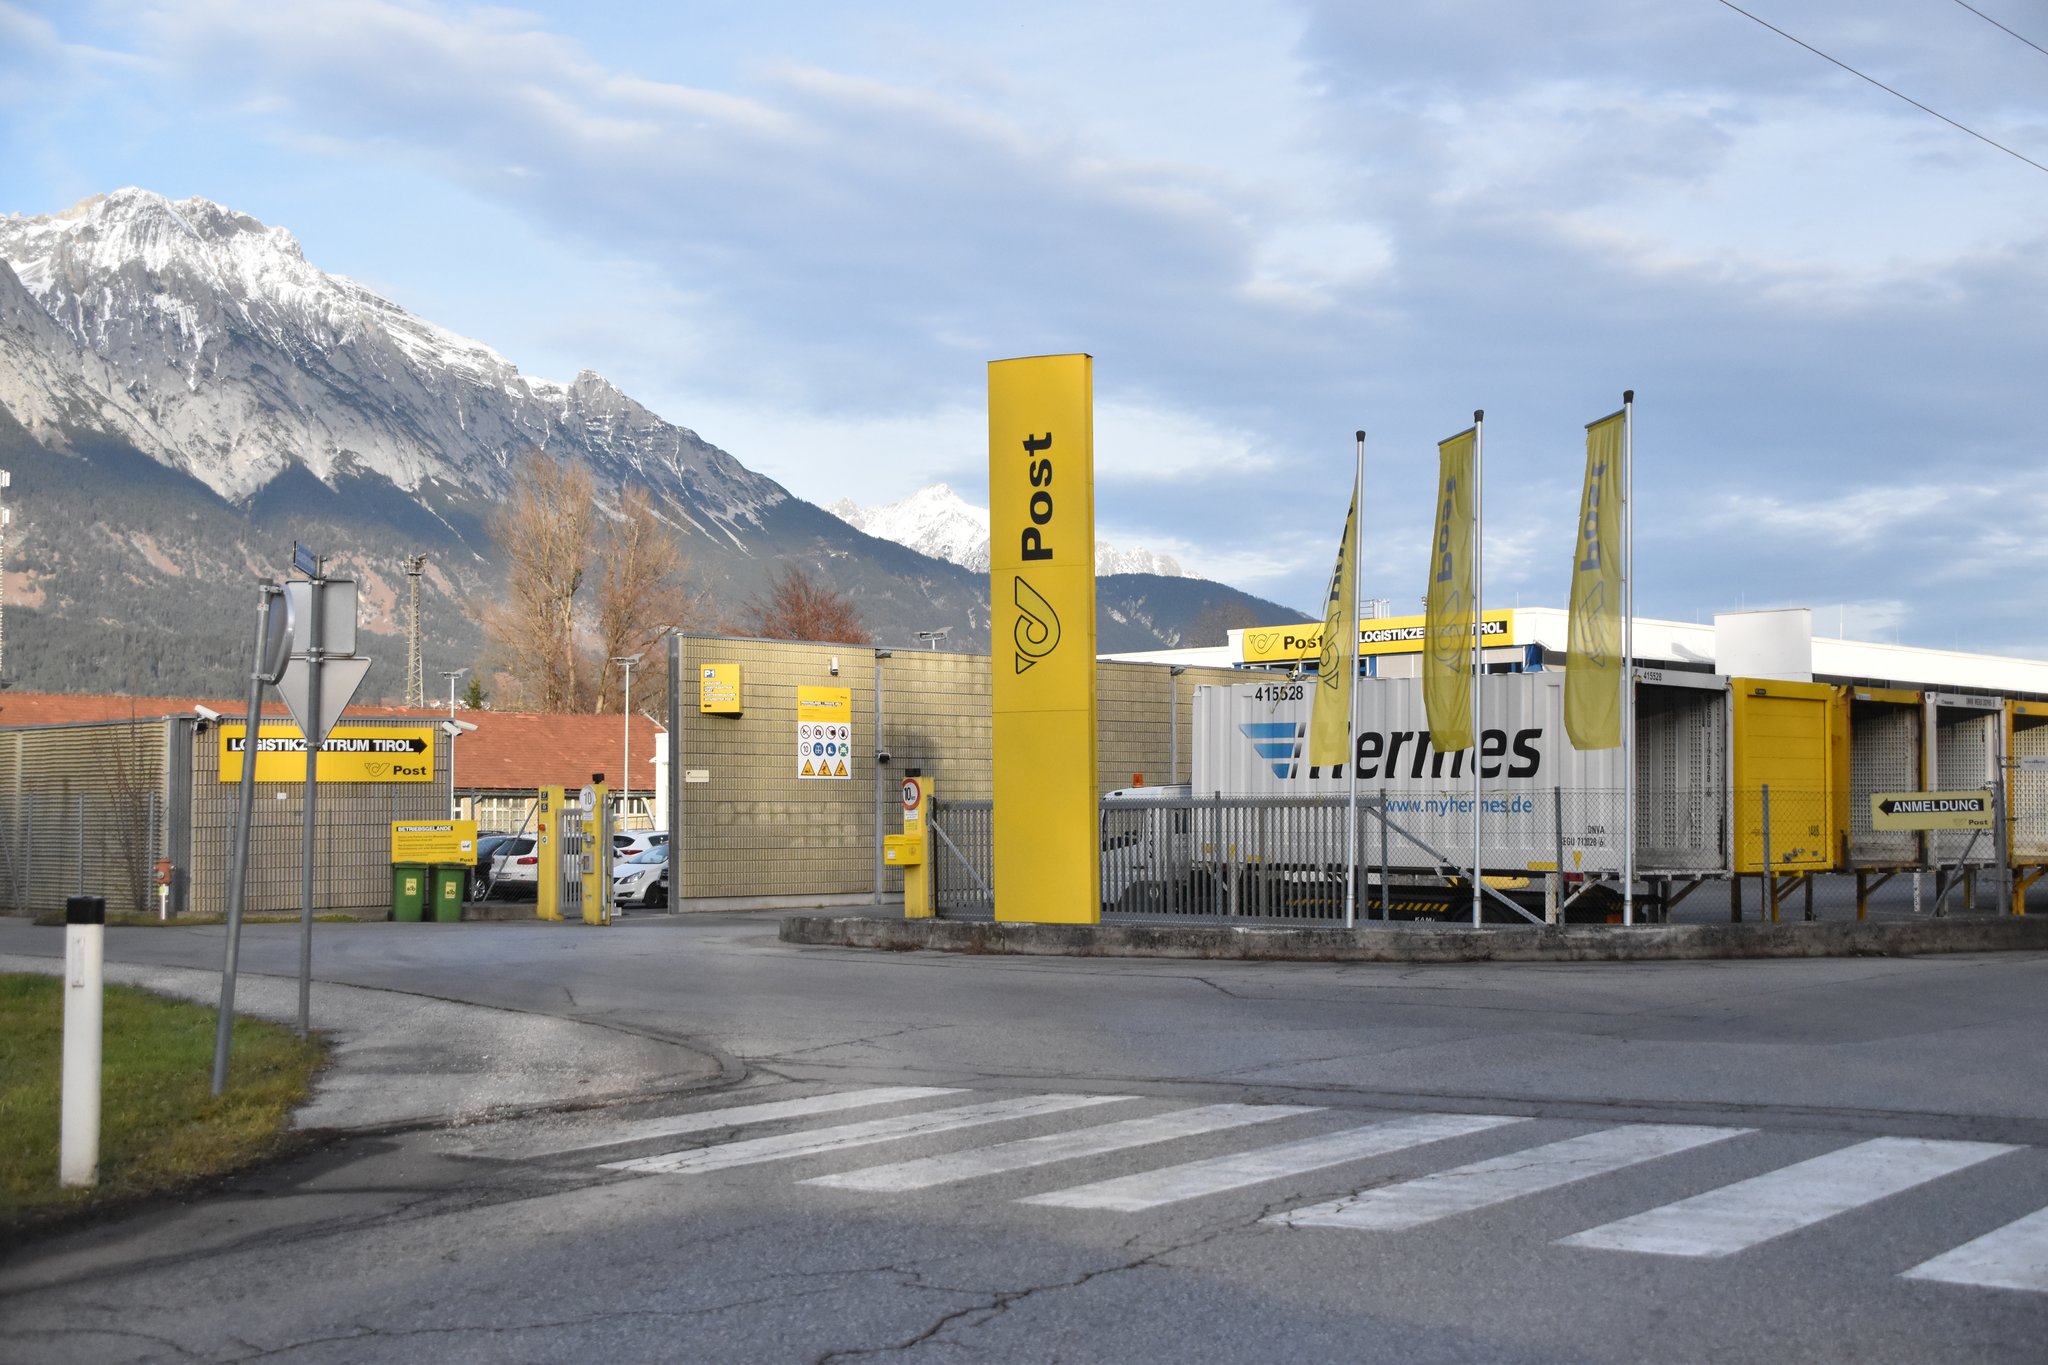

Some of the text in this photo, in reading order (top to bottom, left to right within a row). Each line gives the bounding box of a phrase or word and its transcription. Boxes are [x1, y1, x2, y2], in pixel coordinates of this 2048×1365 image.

[1021, 432, 1054, 562] Post
[1283, 621, 1504, 650] Post LOGISTIKZE TROL
[1643, 671, 1662, 682] 415528
[1255, 685, 1304, 702] 415528
[231, 738, 414, 752] LOGISTIKZNTRUM TIROL
[1308, 721, 1543, 779] ermes
[393, 766, 427, 775] Post
[583, 791, 593, 805] 10
[904, 787, 912, 800] 10
[1386, 795, 1532, 817] www.myhermes.de
[1893, 799, 1979, 812] ANMELDUNG
